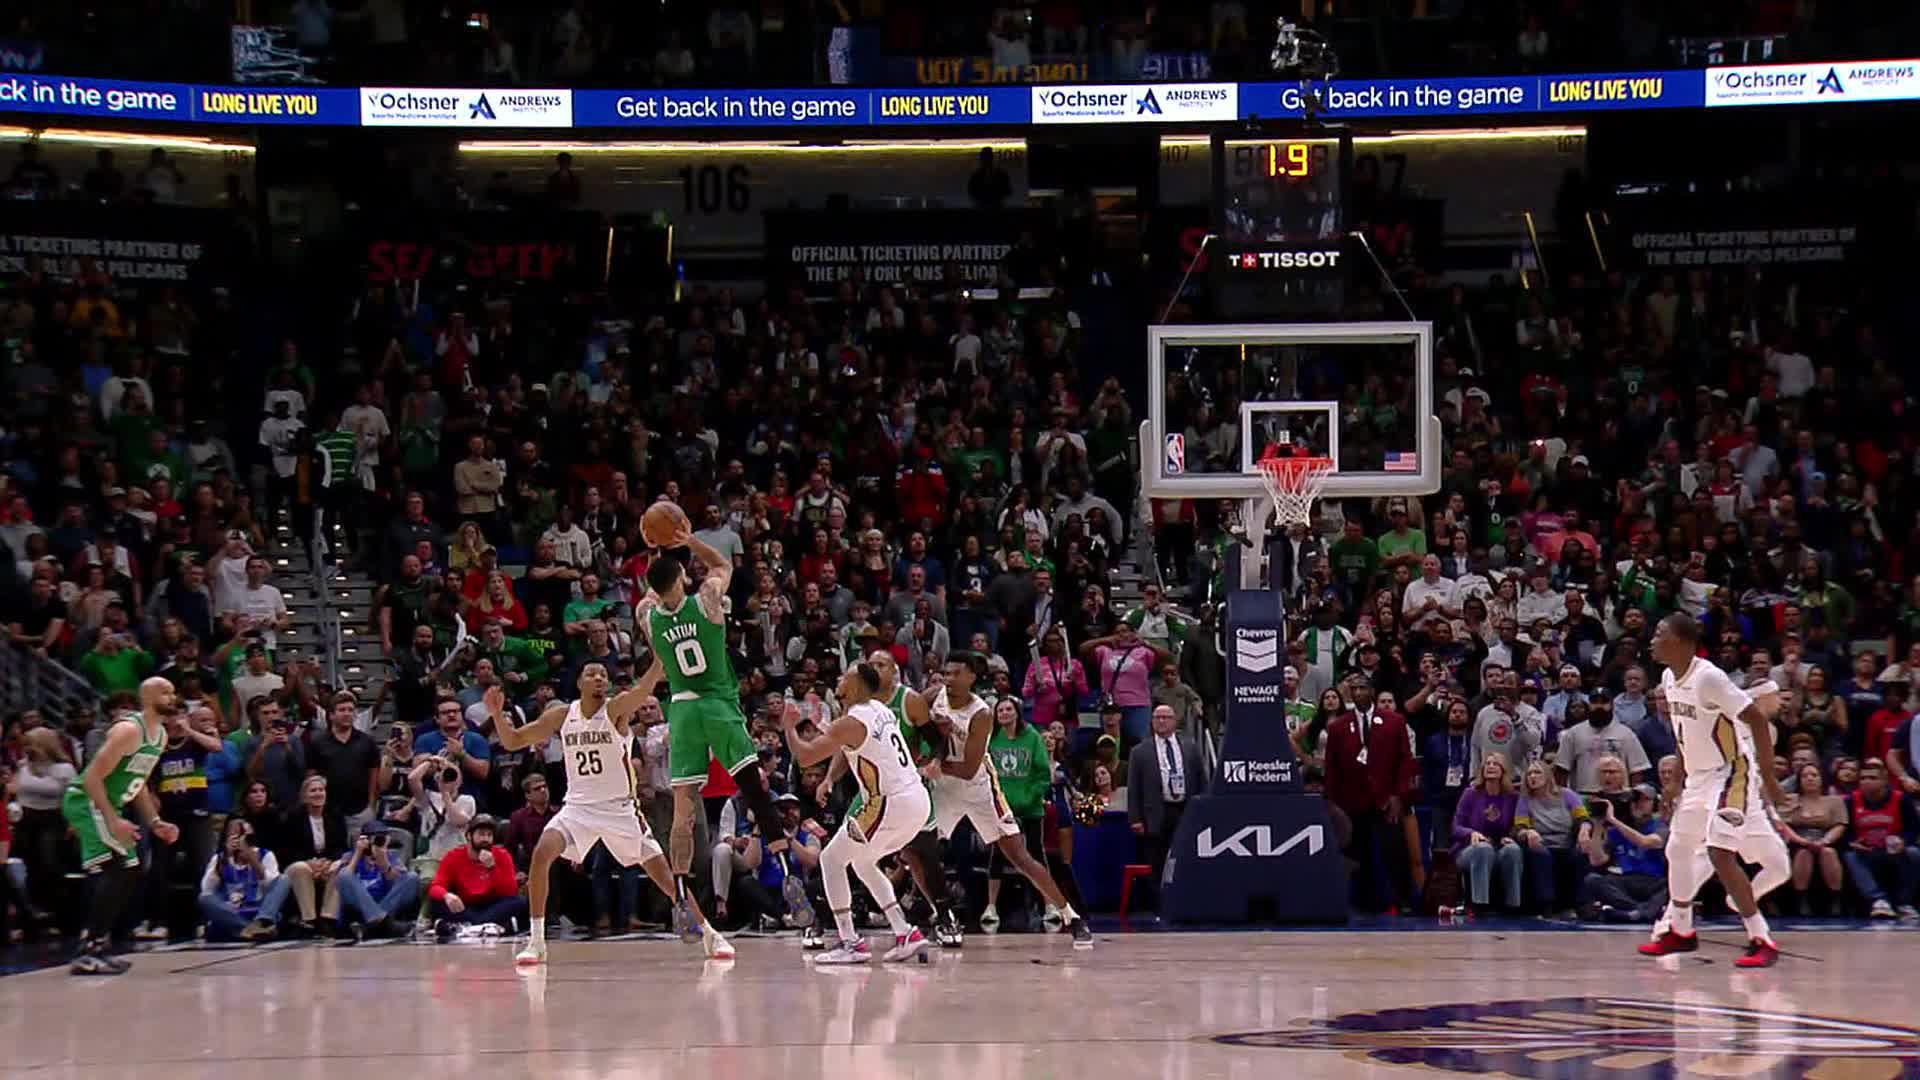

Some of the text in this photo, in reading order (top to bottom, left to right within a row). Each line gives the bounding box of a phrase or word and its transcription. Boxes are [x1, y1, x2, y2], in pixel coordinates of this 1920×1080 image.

[1726, 72, 1807, 88] Ochsner
[1850, 67, 1914, 79] ANDREWS
[33, 82, 54, 103] in
[60, 83, 101, 106] the
[107, 89, 176, 111] game
[1051, 91, 1127, 107] Ochsner
[1166, 89, 1227, 100] ANDREWS
[1329, 86, 1383, 108] back
[1389, 84, 1409, 106] in
[1415, 83, 1451, 105] the
[1458, 87, 1523, 109] game
[1550, 78, 1662, 102] LONG LIVE YOU
[203, 92, 317, 116] LONG LIVE YOU
[380, 93, 460, 110] Ochsner
[500, 96, 561, 106] ANDREWS
[617, 95, 856, 120] Get back in the game
[881, 96, 989, 116] LONG LIVE YOU
[1269, 143, 1309, 177] 1.9
[680, 165, 749, 213] 106
[14, 235, 101, 256] TICKETING
[104, 240, 178, 258] PARTNER
[180, 242, 202, 259] OF
[1632, 231, 1695, 248] OFFICIAL
[792, 245, 858, 262] OFFICIAL
[861, 245, 941, 262] TICKETING
[1258, 252, 1340, 268] TISSOT
[108, 261, 189, 280] PELICANS
[806, 266, 833, 282] THE
[661, 623, 697, 644] TATUM
[1236, 627, 1278, 638] Chevron
[674, 638, 708, 677] 0
[1234, 685, 1279, 697] NEWAGE
[890, 733, 908, 768] 3
[576, 749, 603, 776] 25
[1248, 760, 1291, 771] Keesler
[1248, 771, 1291, 783] Federal
[1197, 824, 1324, 857] KIA
